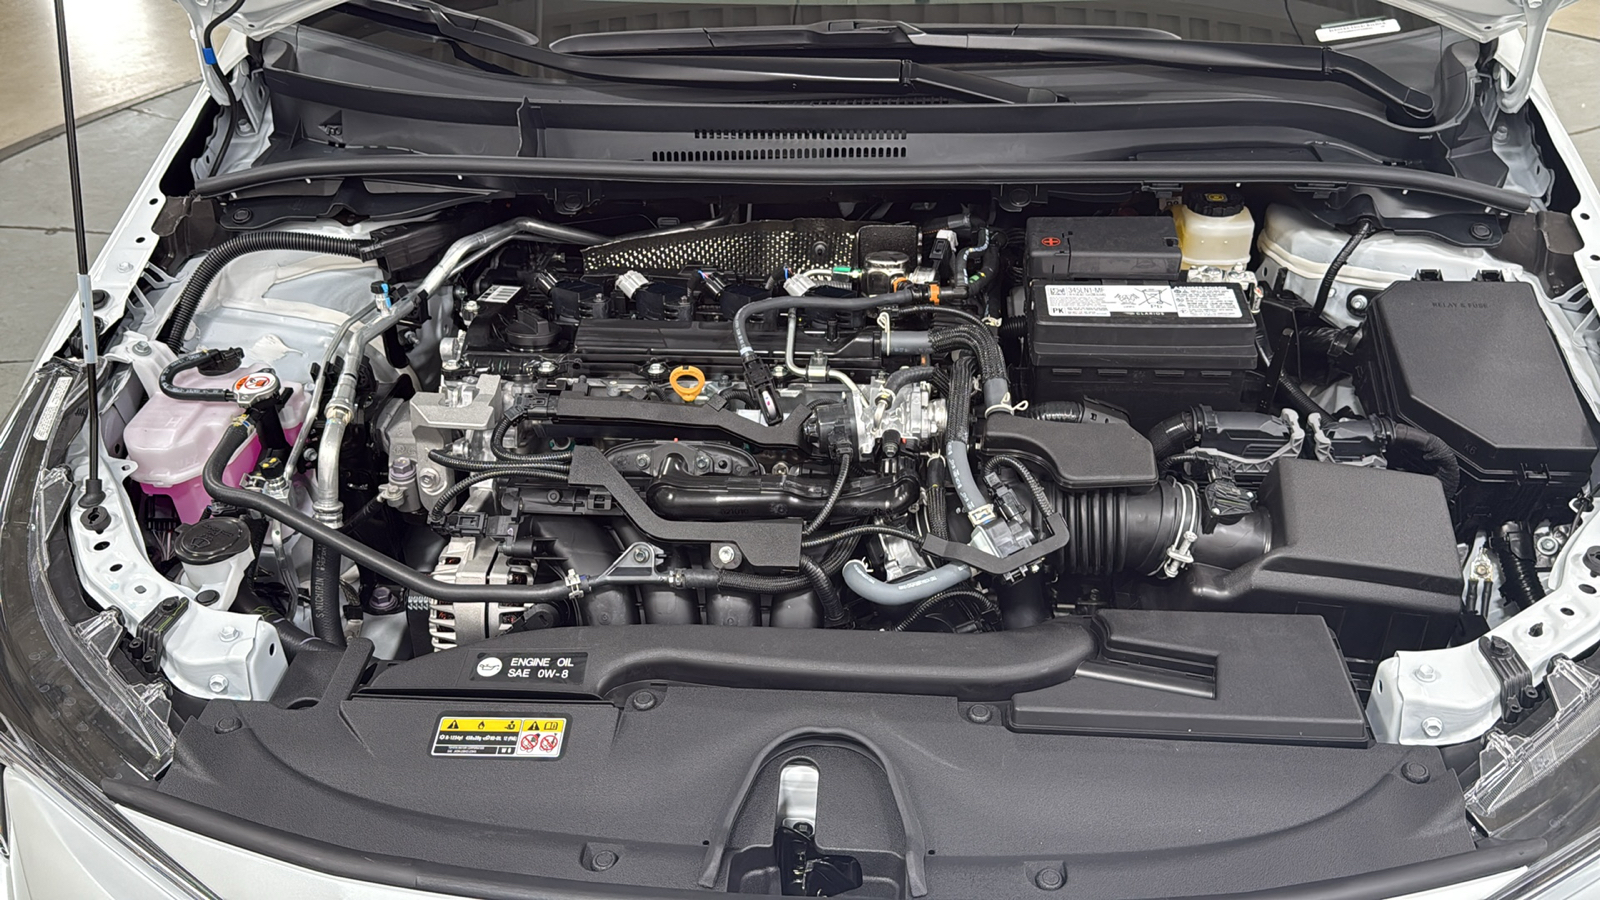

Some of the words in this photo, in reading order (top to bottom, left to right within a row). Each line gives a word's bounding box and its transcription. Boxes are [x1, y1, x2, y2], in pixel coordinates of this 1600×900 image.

[510, 657, 551, 667] ENGINE
[556, 657, 574, 667] OIL
[507, 668, 531, 678] SAE
[537, 669, 569, 679] 0W-8
